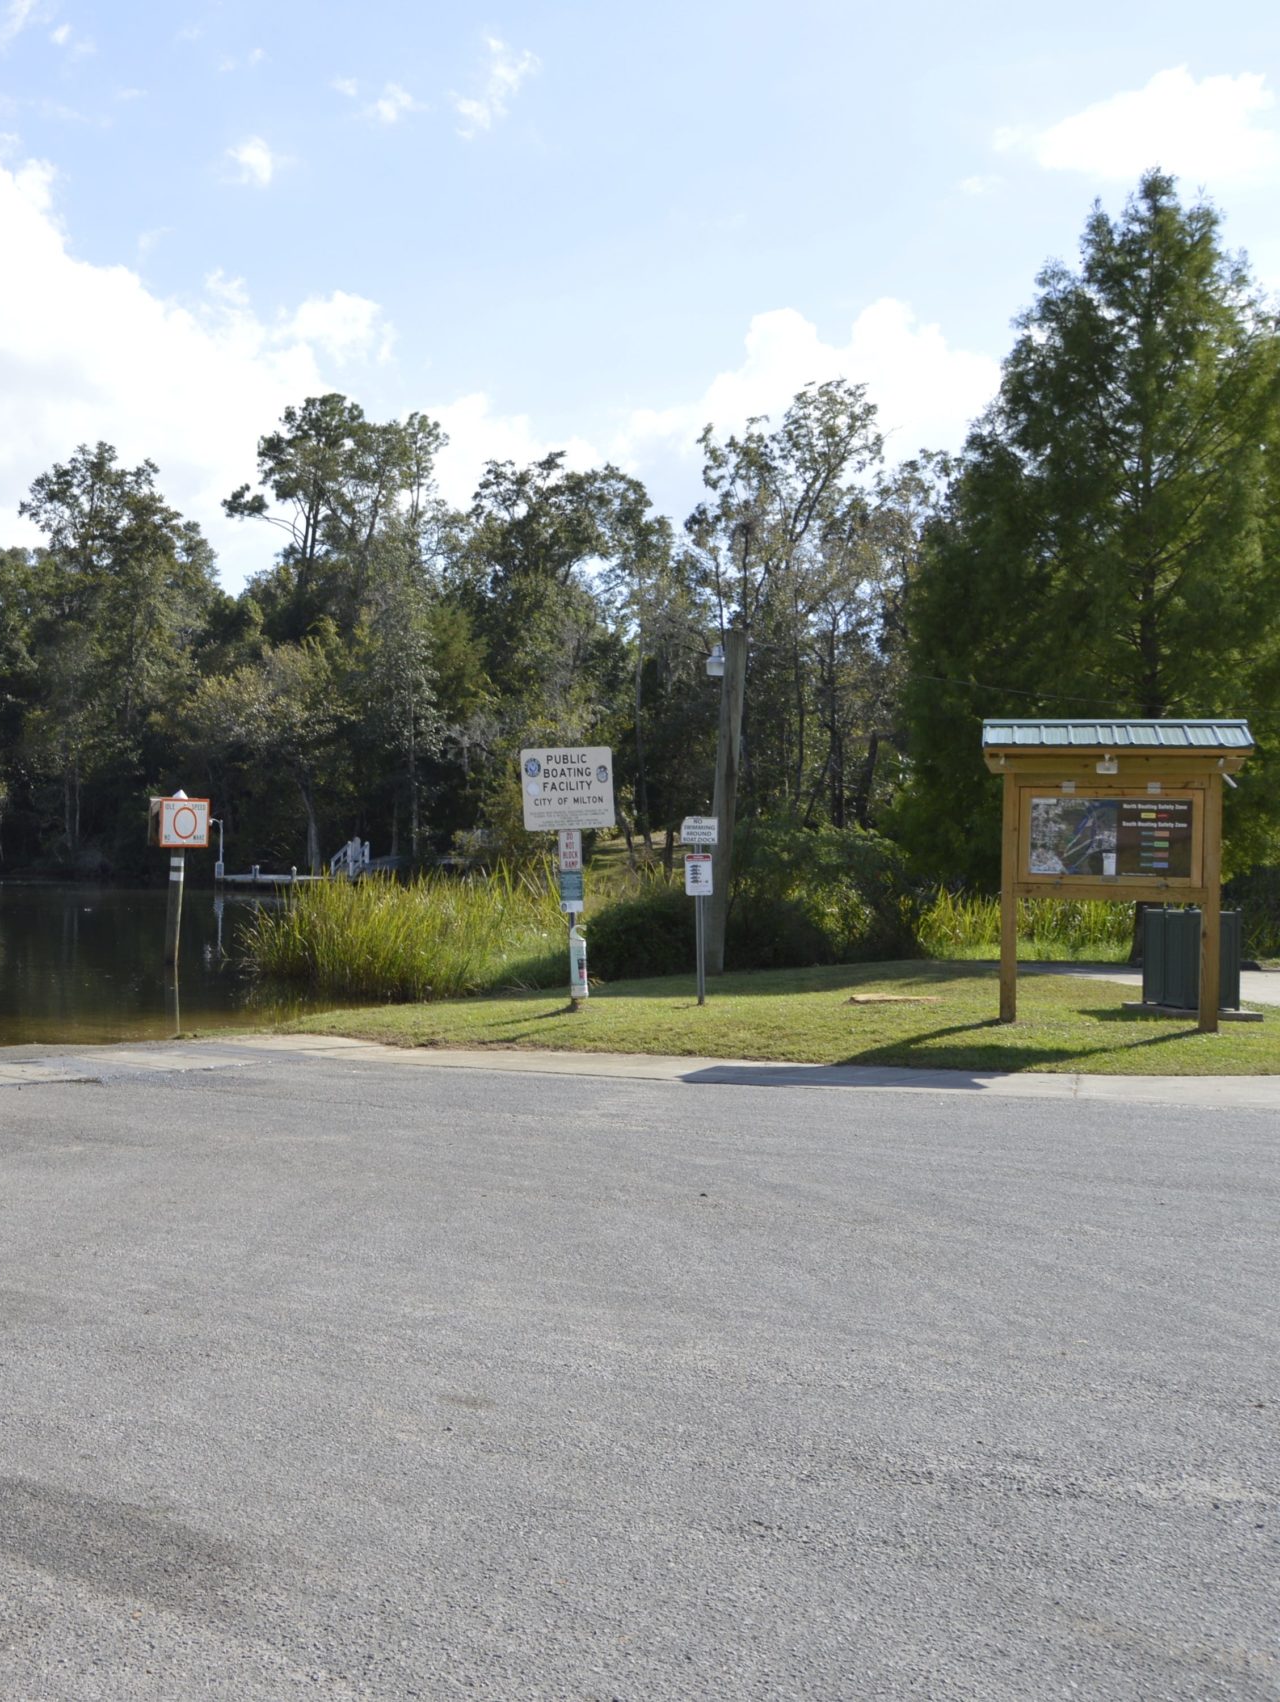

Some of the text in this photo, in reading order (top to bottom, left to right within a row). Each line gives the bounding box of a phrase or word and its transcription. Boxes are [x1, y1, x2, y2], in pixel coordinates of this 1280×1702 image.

[546, 754, 587, 765] PUBLIC
[543, 767, 592, 778] BOATING
[542, 781, 593, 792] FACILITY
[534, 798, 553, 806] CITY
[573, 796, 604, 804] MILTON
